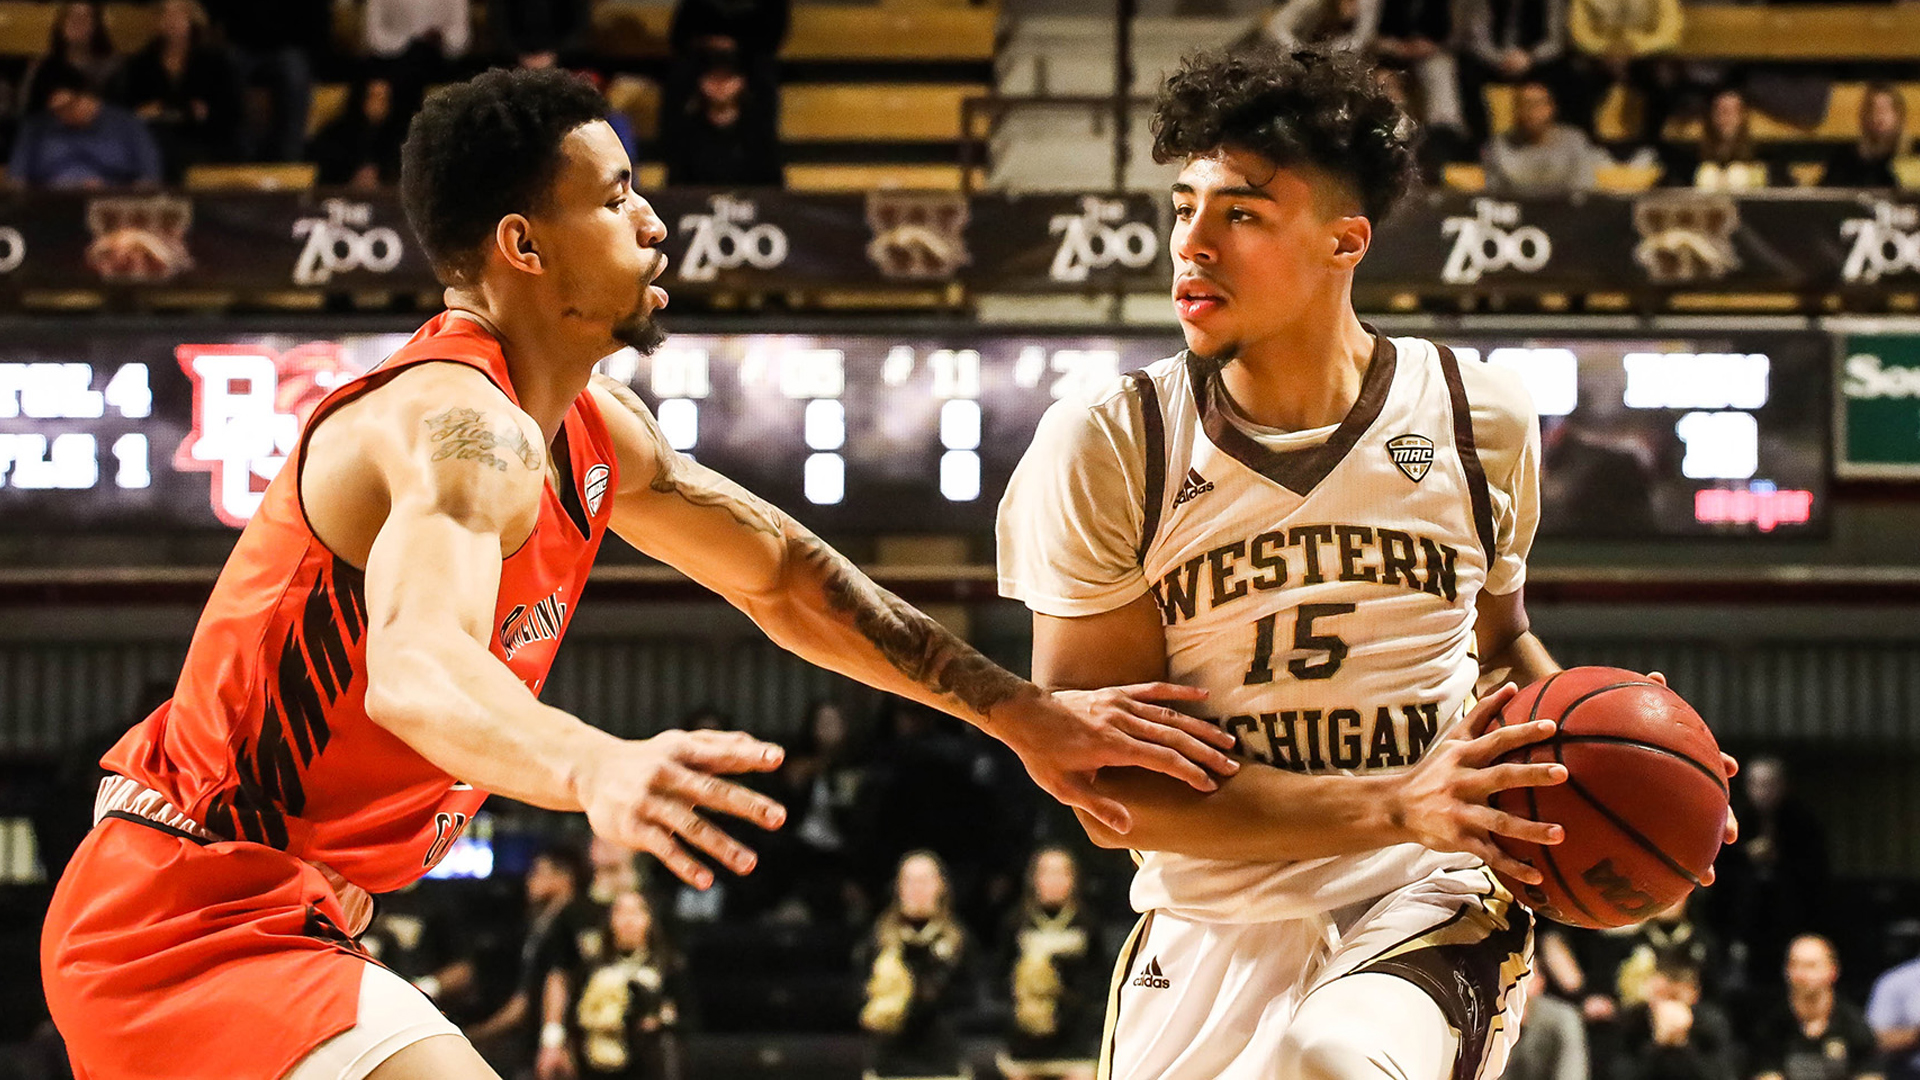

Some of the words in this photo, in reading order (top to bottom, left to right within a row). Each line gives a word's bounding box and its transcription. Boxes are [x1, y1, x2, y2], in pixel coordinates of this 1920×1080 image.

[105, 363, 152, 418] 4
[112, 433, 150, 488] 1
[1393, 449, 1434, 462] MAC
[1150, 525, 1458, 625] WESTERN
[1242, 602, 1356, 686] 15
[1203, 703, 1440, 770] CHIGAN
